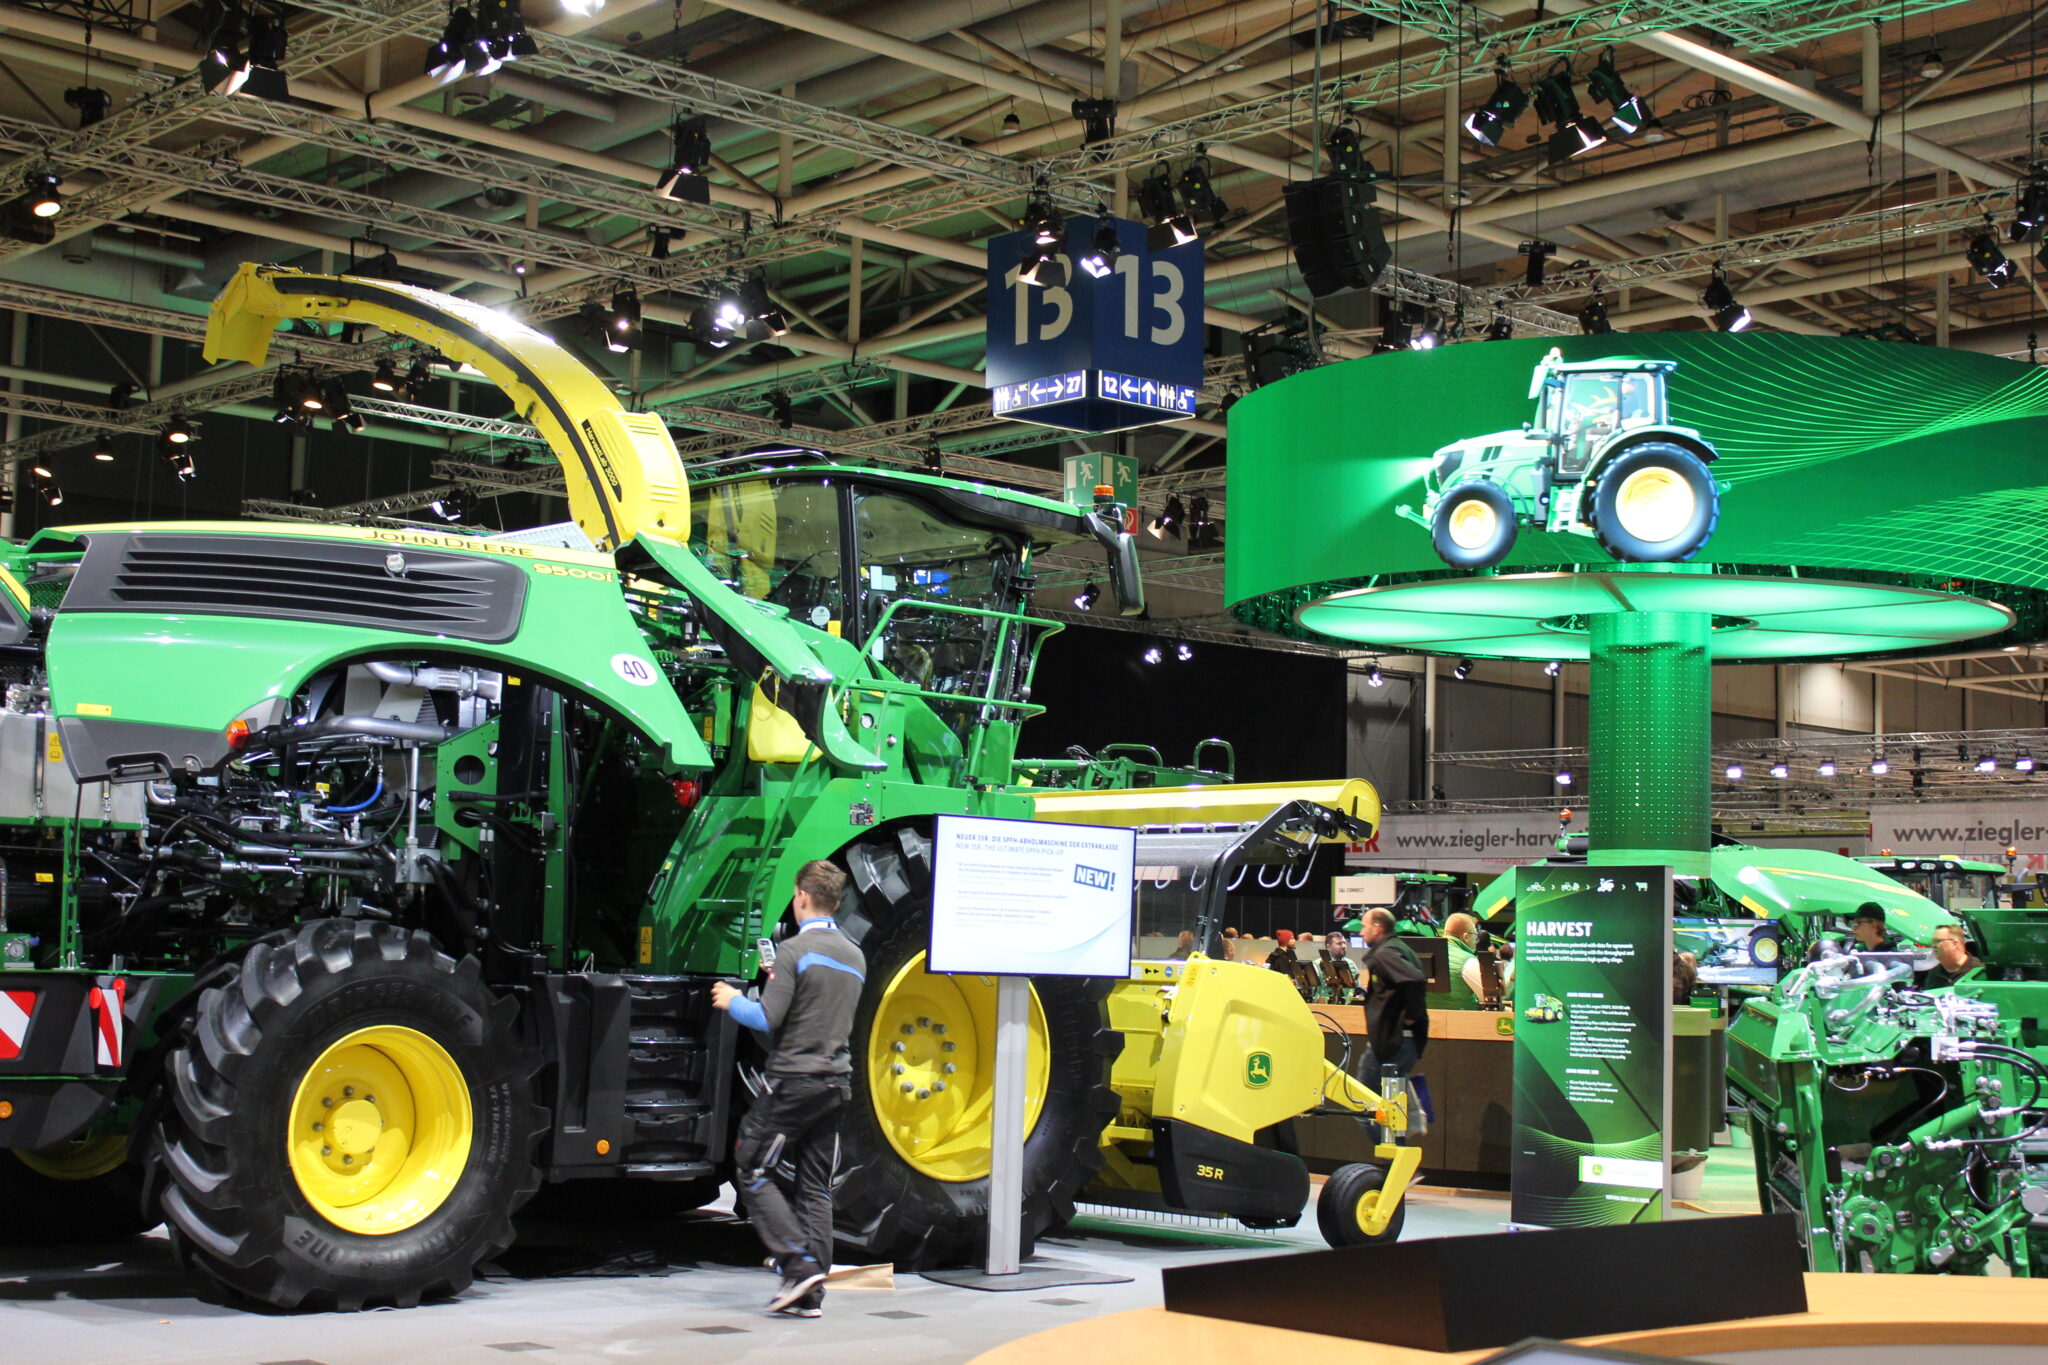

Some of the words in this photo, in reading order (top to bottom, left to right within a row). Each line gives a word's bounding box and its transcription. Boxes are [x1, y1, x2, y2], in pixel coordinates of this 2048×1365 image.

[1115, 254, 1186, 346] 13
[1067, 375, 1081, 394] 27
[1104, 376, 1118, 395] 12
[604, 466, 618, 487] 3000
[364, 530, 438, 548] JOHN
[450, 535, 535, 558] DEERE
[622, 659, 649, 681] 40
[1069, 840, 1081, 848] DER
[1526, 921, 1592, 937] HARVEST
